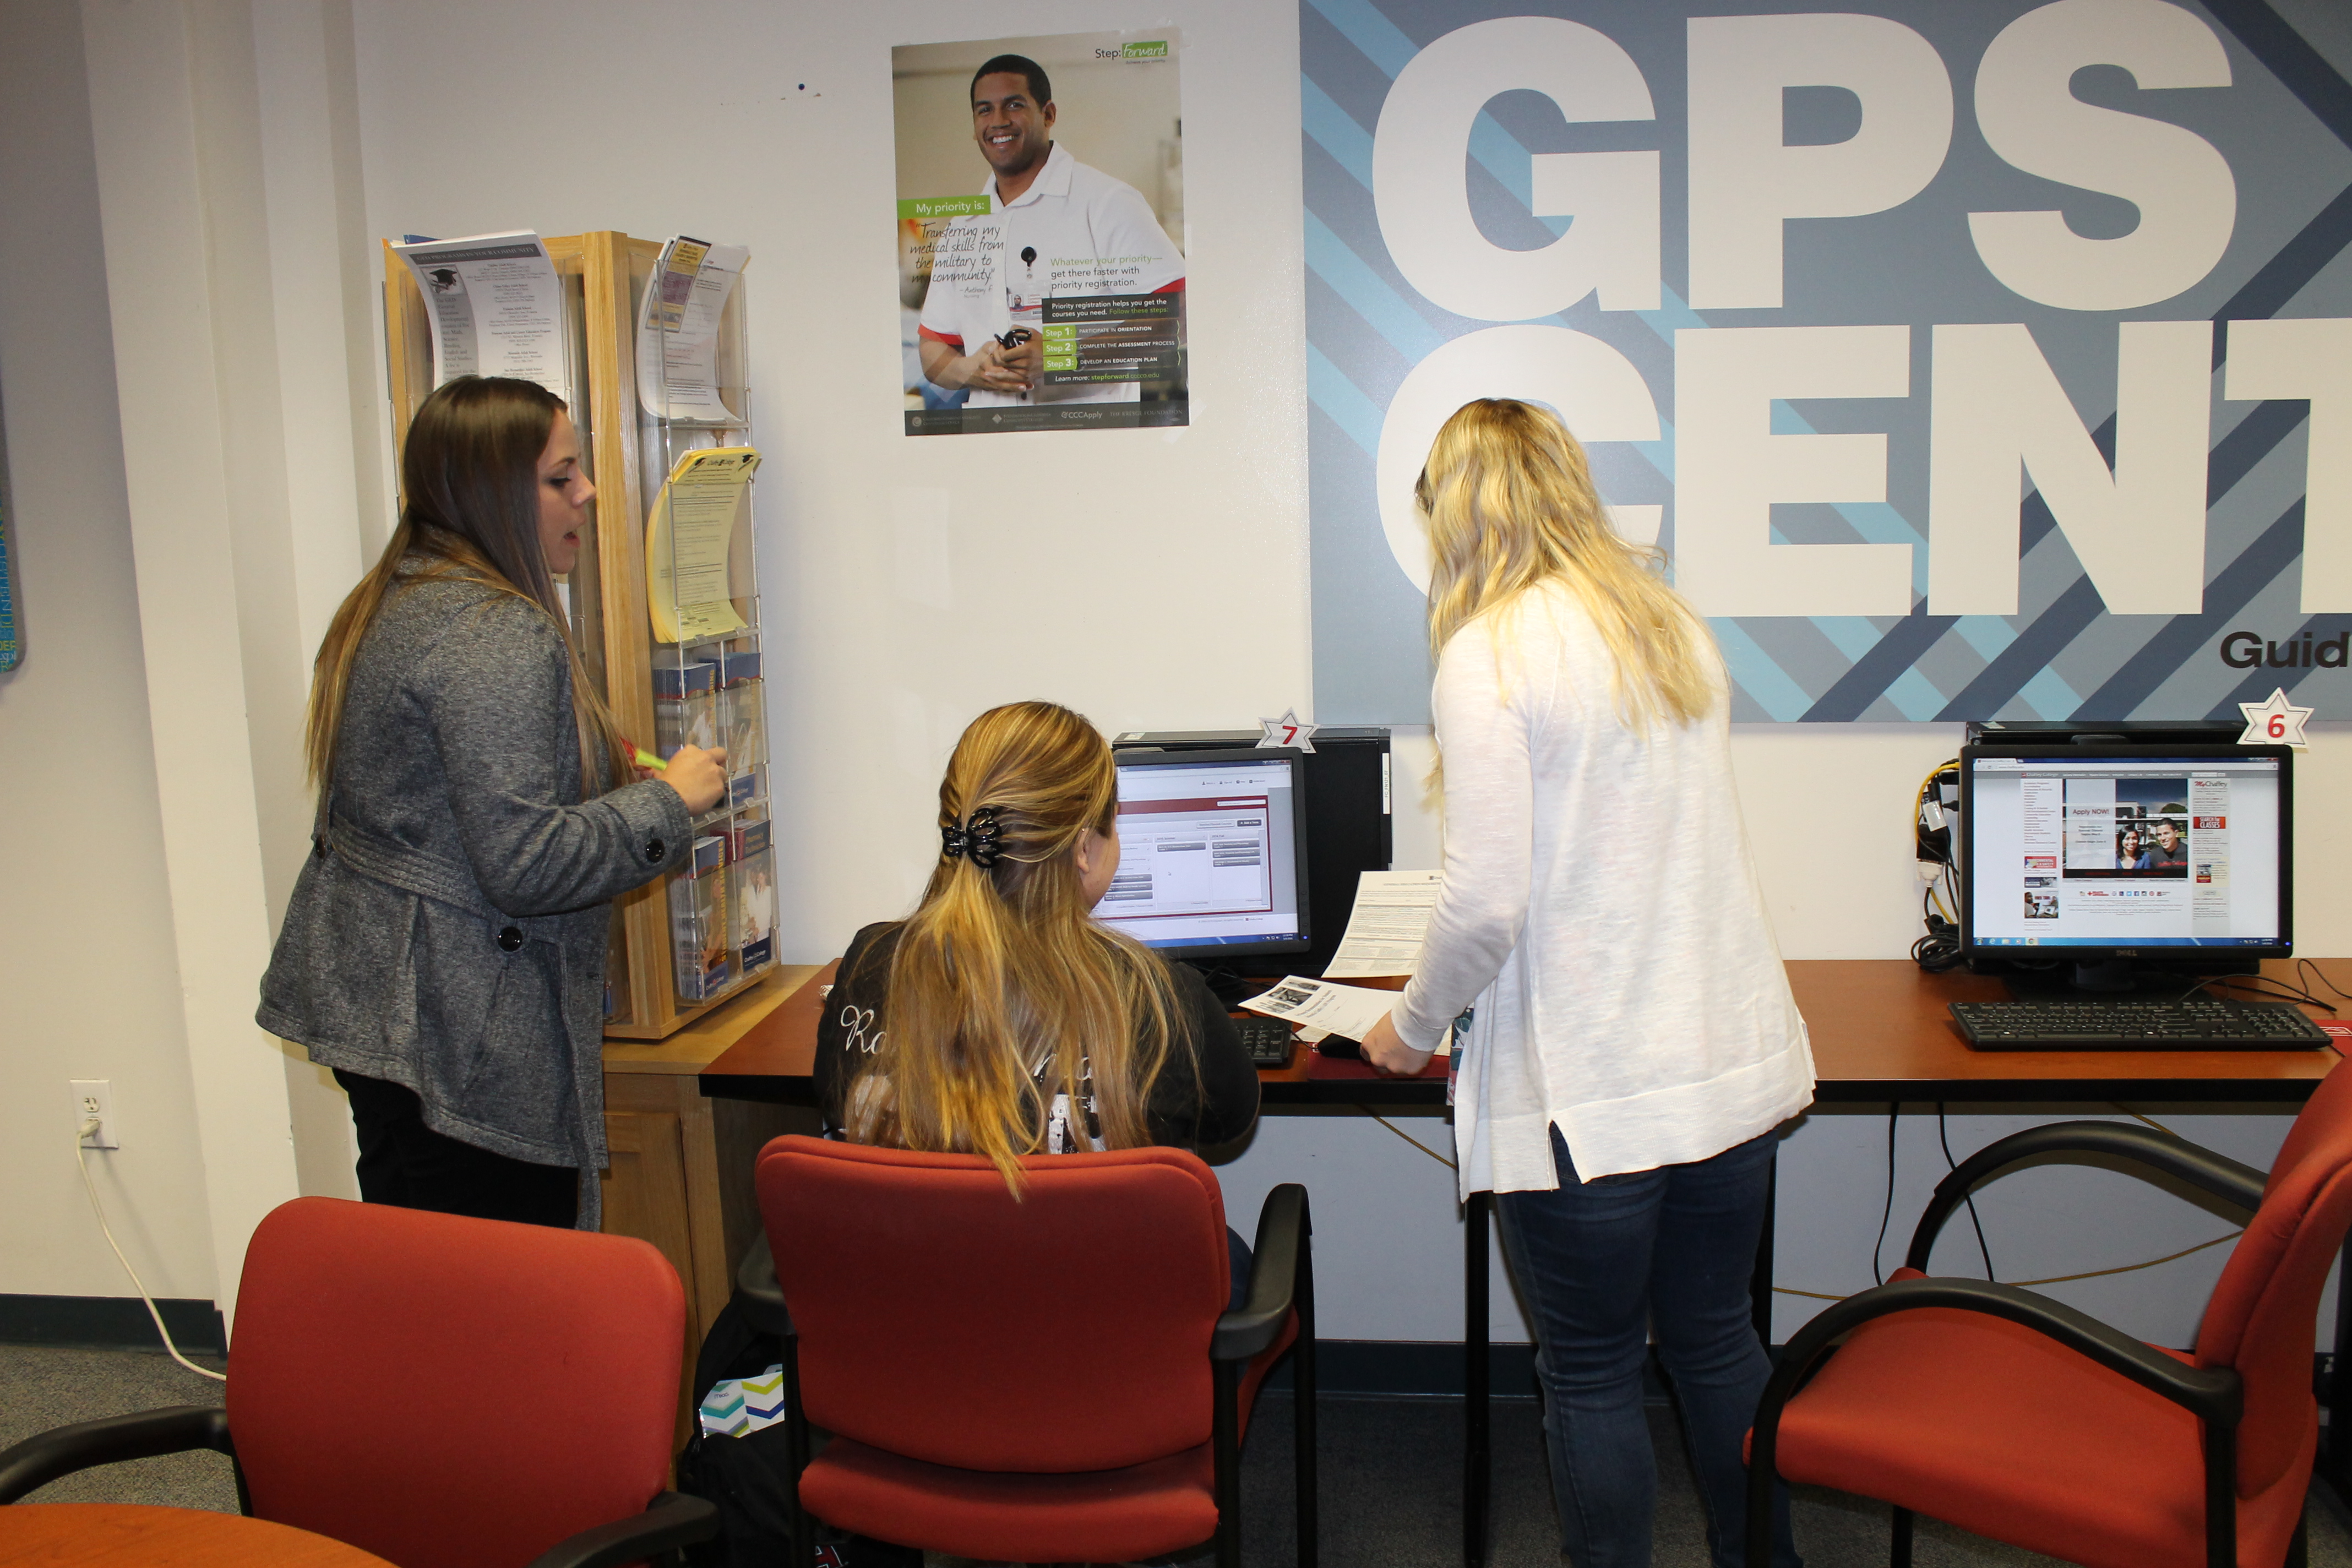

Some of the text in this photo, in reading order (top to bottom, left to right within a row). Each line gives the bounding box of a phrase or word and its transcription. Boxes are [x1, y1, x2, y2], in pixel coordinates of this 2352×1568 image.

[1095, 43, 1166, 61] Step: Forward
[1372, 0, 2237, 322] GPS
[916, 200, 984, 215] My priority is:
[982, 226, 1001, 241] my
[910, 236, 1004, 254] medical skills from
[916, 254, 992, 272] the military to
[1050, 258, 1093, 266] Whatever
[1096, 257, 1116, 268] your
[1051, 266, 1140, 280] get there faster with
[964, 286, 986, 294] Anthony
[1051, 278, 1137, 291] priority registration.
[1075, 301, 1111, 310] registration
[1112, 300, 1129, 308] helps
[1046, 327, 1073, 337] Step 1:
[1047, 342, 1074, 353] Step 2:
[1047, 358, 1074, 368] Step 3:
[1068, 411, 1103, 420] CCCApply
[2220, 631, 2351, 668] Guid
[2268, 714, 2285, 738] 6
[1282, 725, 1298, 745] 7
